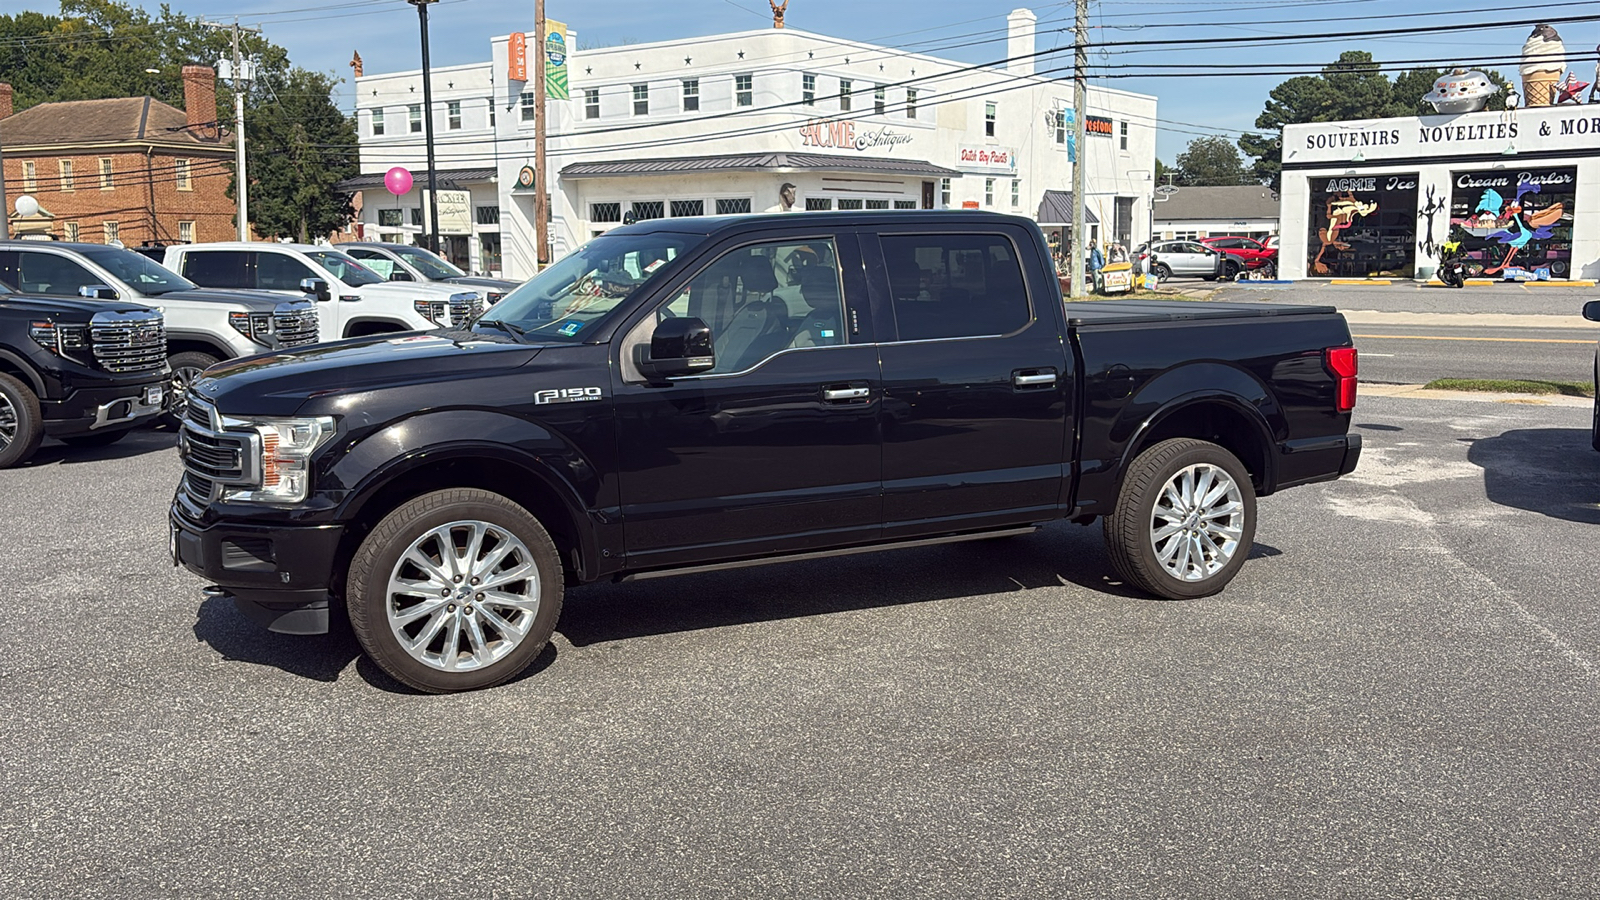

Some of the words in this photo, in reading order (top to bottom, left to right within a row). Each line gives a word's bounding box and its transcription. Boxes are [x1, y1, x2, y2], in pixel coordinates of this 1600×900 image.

[516, 36, 524, 77] ACME
[799, 118, 857, 149] ACME
[858, 125, 913, 152] Antiques
[1306, 129, 1400, 149] SOUVENIRS
[1419, 122, 1519, 143] NOVELTIES
[1538, 120, 1552, 137] &
[961, 148, 978, 162] Dutch
[979, 150, 990, 165] Boy
[990, 150, 1008, 164] Paints
[1325, 177, 1377, 193] ACME
[1385, 176, 1417, 191] Ice
[1456, 173, 1510, 189] Cream
[1516, 171, 1574, 187] Parlor
[533, 386, 602, 405] F150
